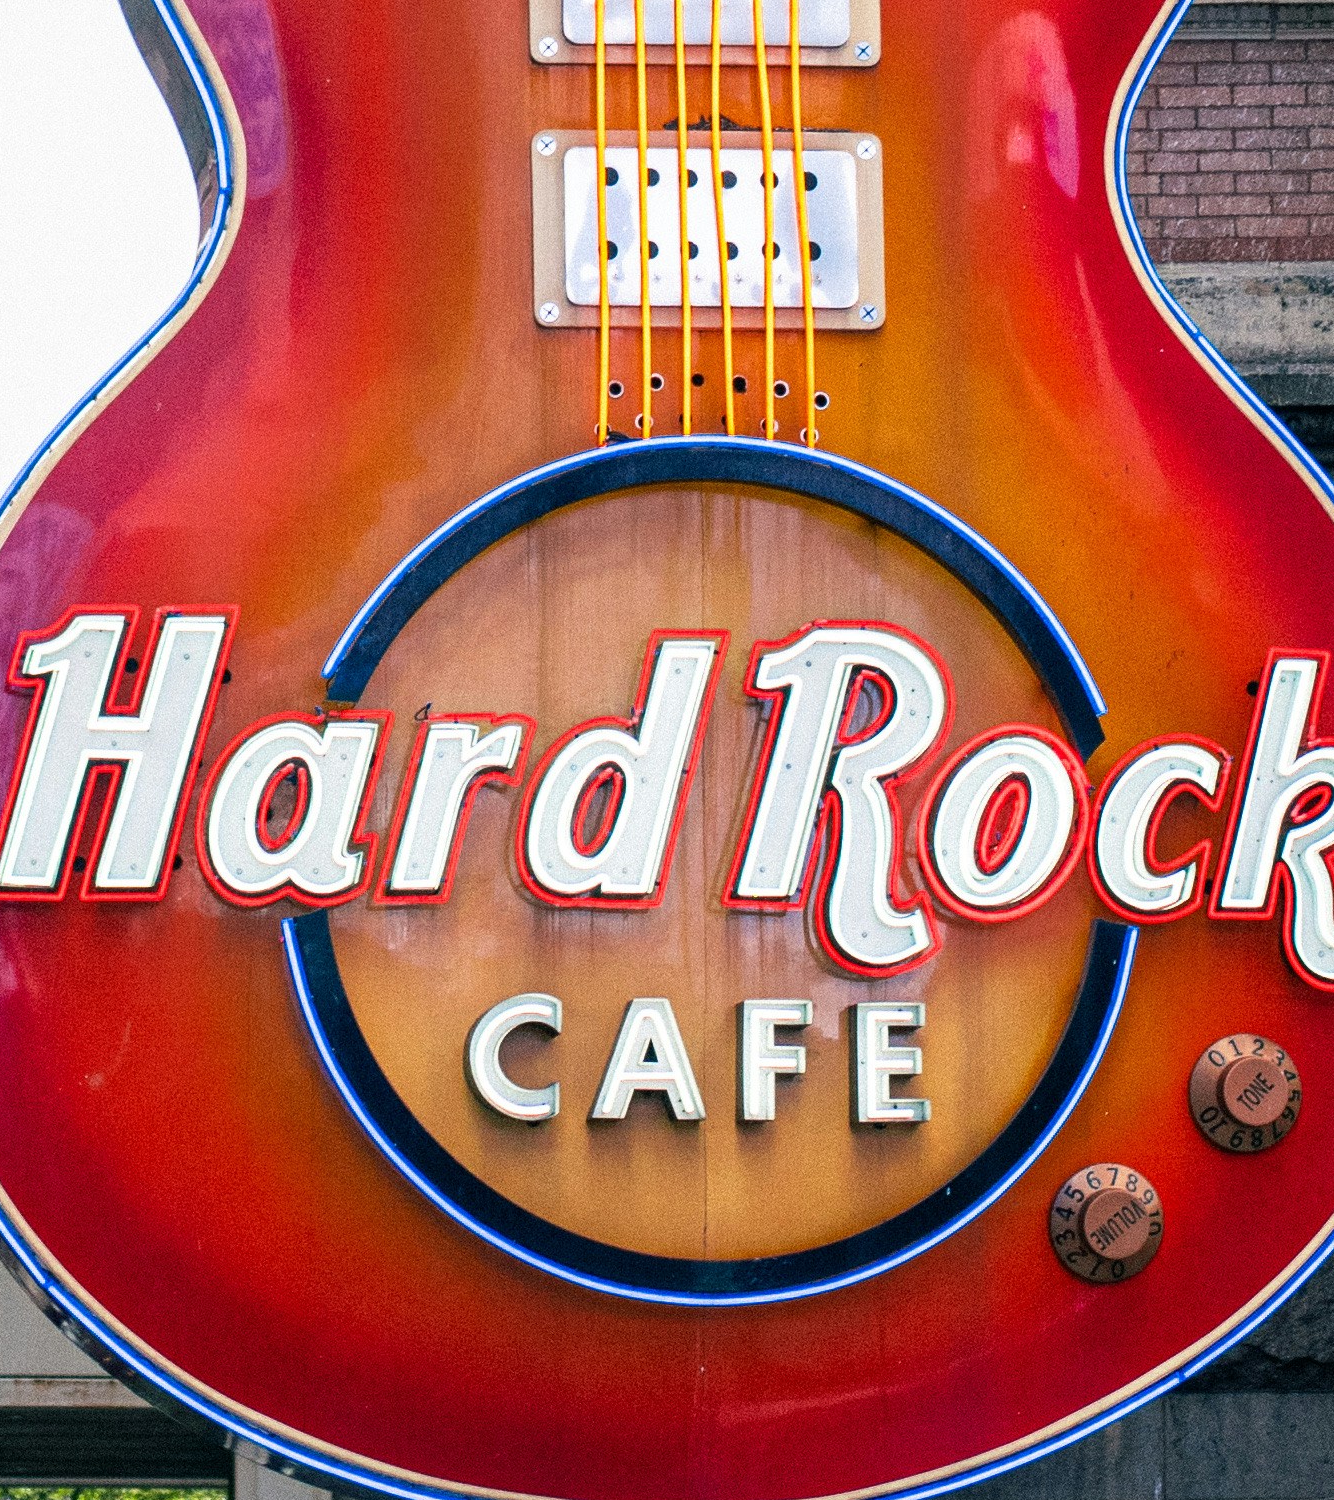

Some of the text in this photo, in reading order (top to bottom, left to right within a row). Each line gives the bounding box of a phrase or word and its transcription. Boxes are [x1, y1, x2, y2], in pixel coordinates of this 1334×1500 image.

[468, 994, 931, 1122] CAFE
[1237, 1073, 1274, 1111] TONE
[1092, 1201, 1145, 1250] VOLUME
